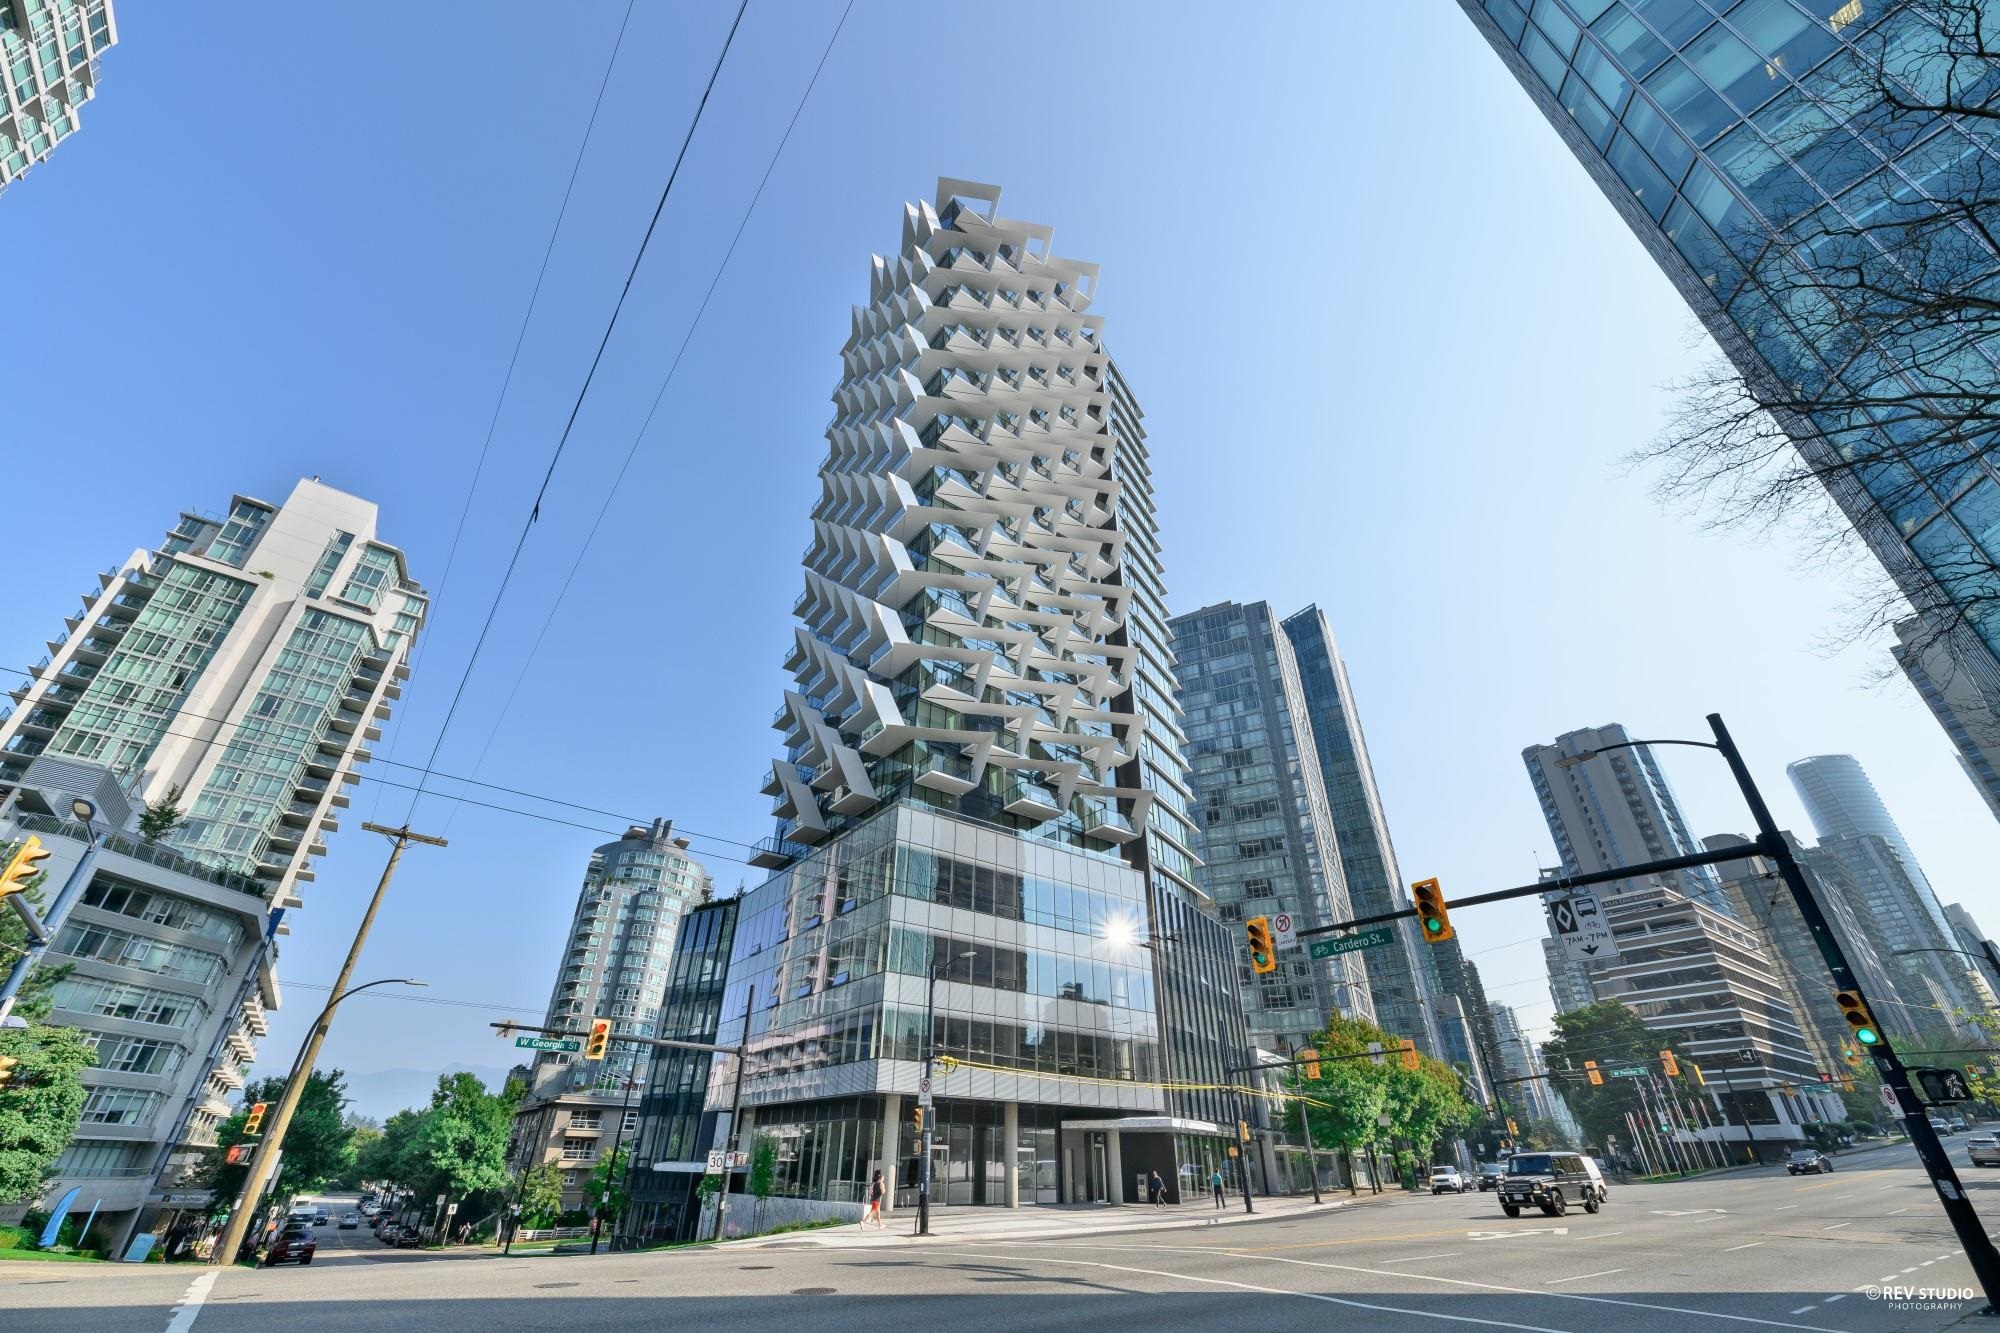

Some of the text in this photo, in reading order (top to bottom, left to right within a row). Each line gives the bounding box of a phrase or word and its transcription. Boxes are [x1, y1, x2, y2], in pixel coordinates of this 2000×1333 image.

[1333, 933, 1385, 952] Cardero St.
[1566, 936, 1583, 946] 7AM
[1591, 932, 1608, 942] 7PM
[520, 1038, 577, 1050] W Georgia St
[710, 1157, 723, 1168] 30
